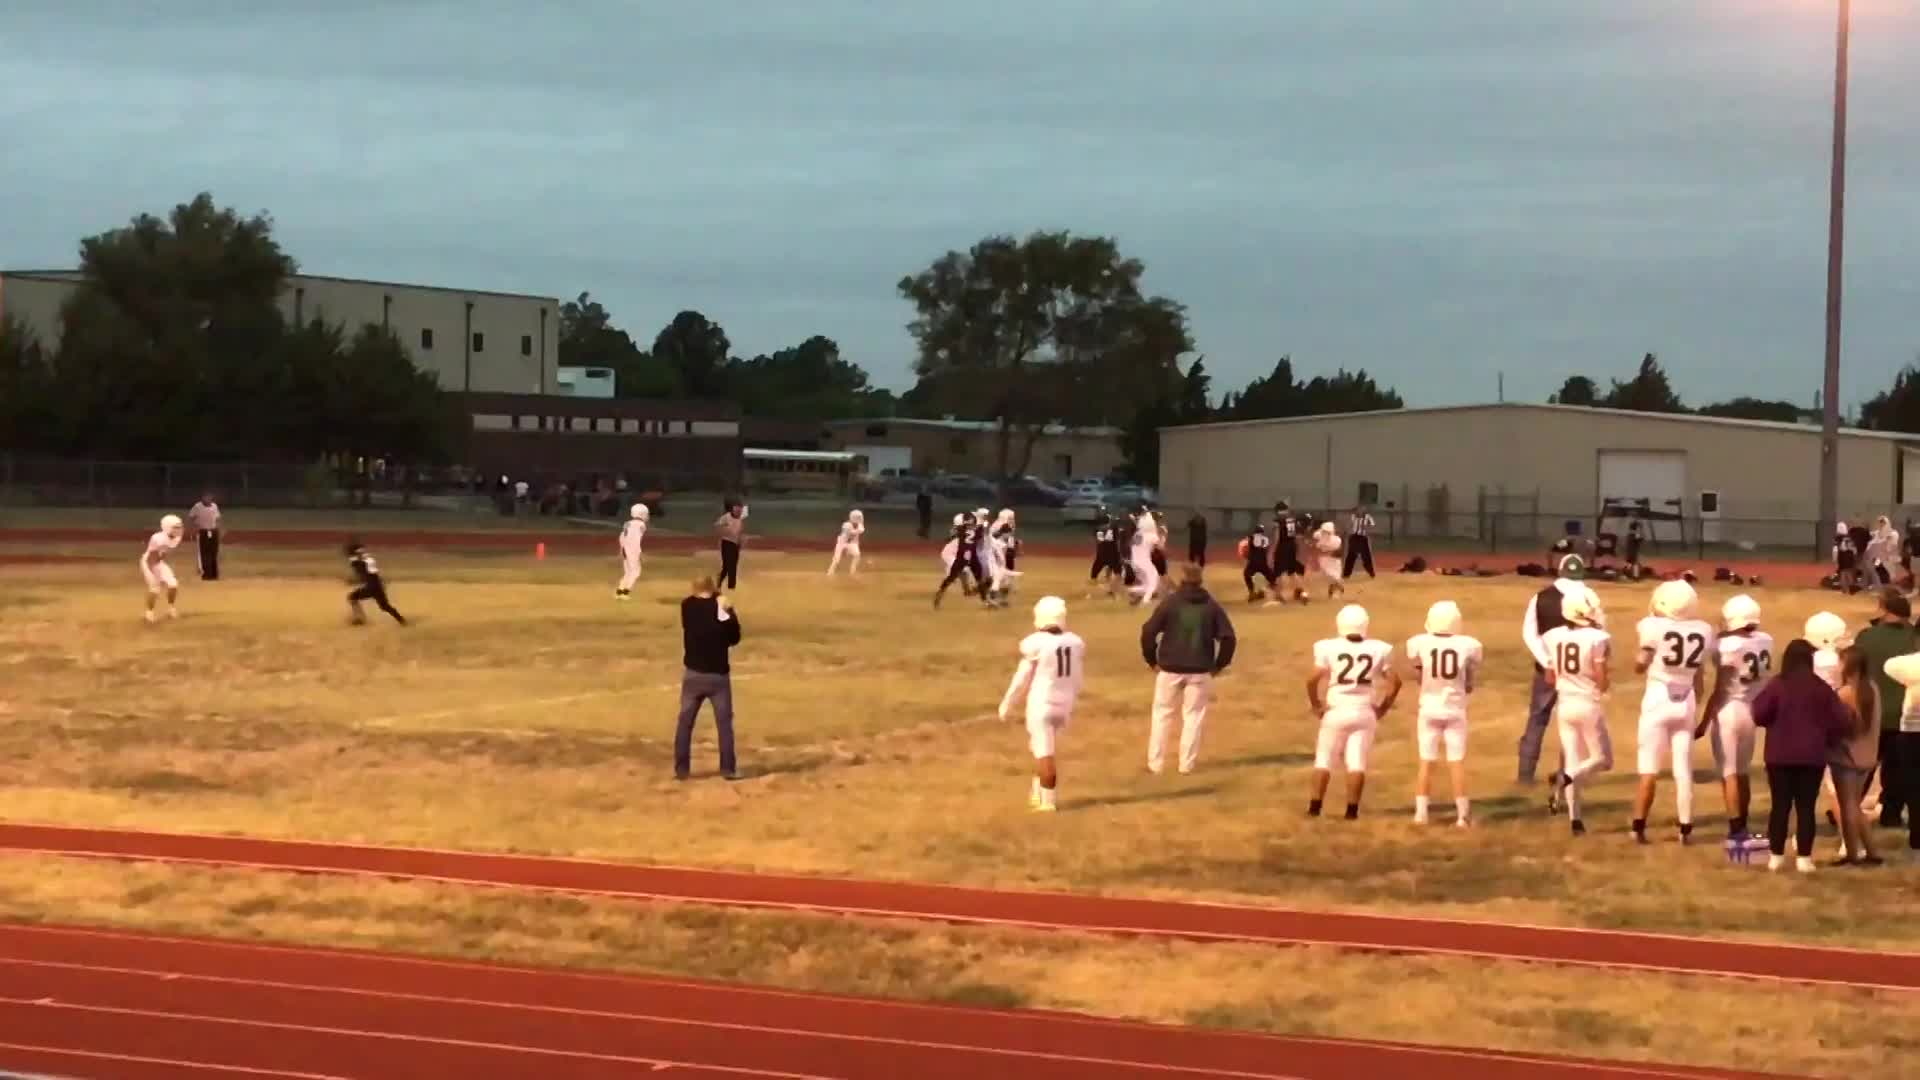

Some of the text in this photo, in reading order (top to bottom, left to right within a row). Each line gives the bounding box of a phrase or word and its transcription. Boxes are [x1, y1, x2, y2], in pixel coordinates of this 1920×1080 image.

[1056, 646, 1071, 677] 11
[1430, 648, 1458, 680] 10
[1556, 642, 1580, 674] 18
[1663, 631, 1704, 668] 32
[1337, 653, 1373, 685] 22
